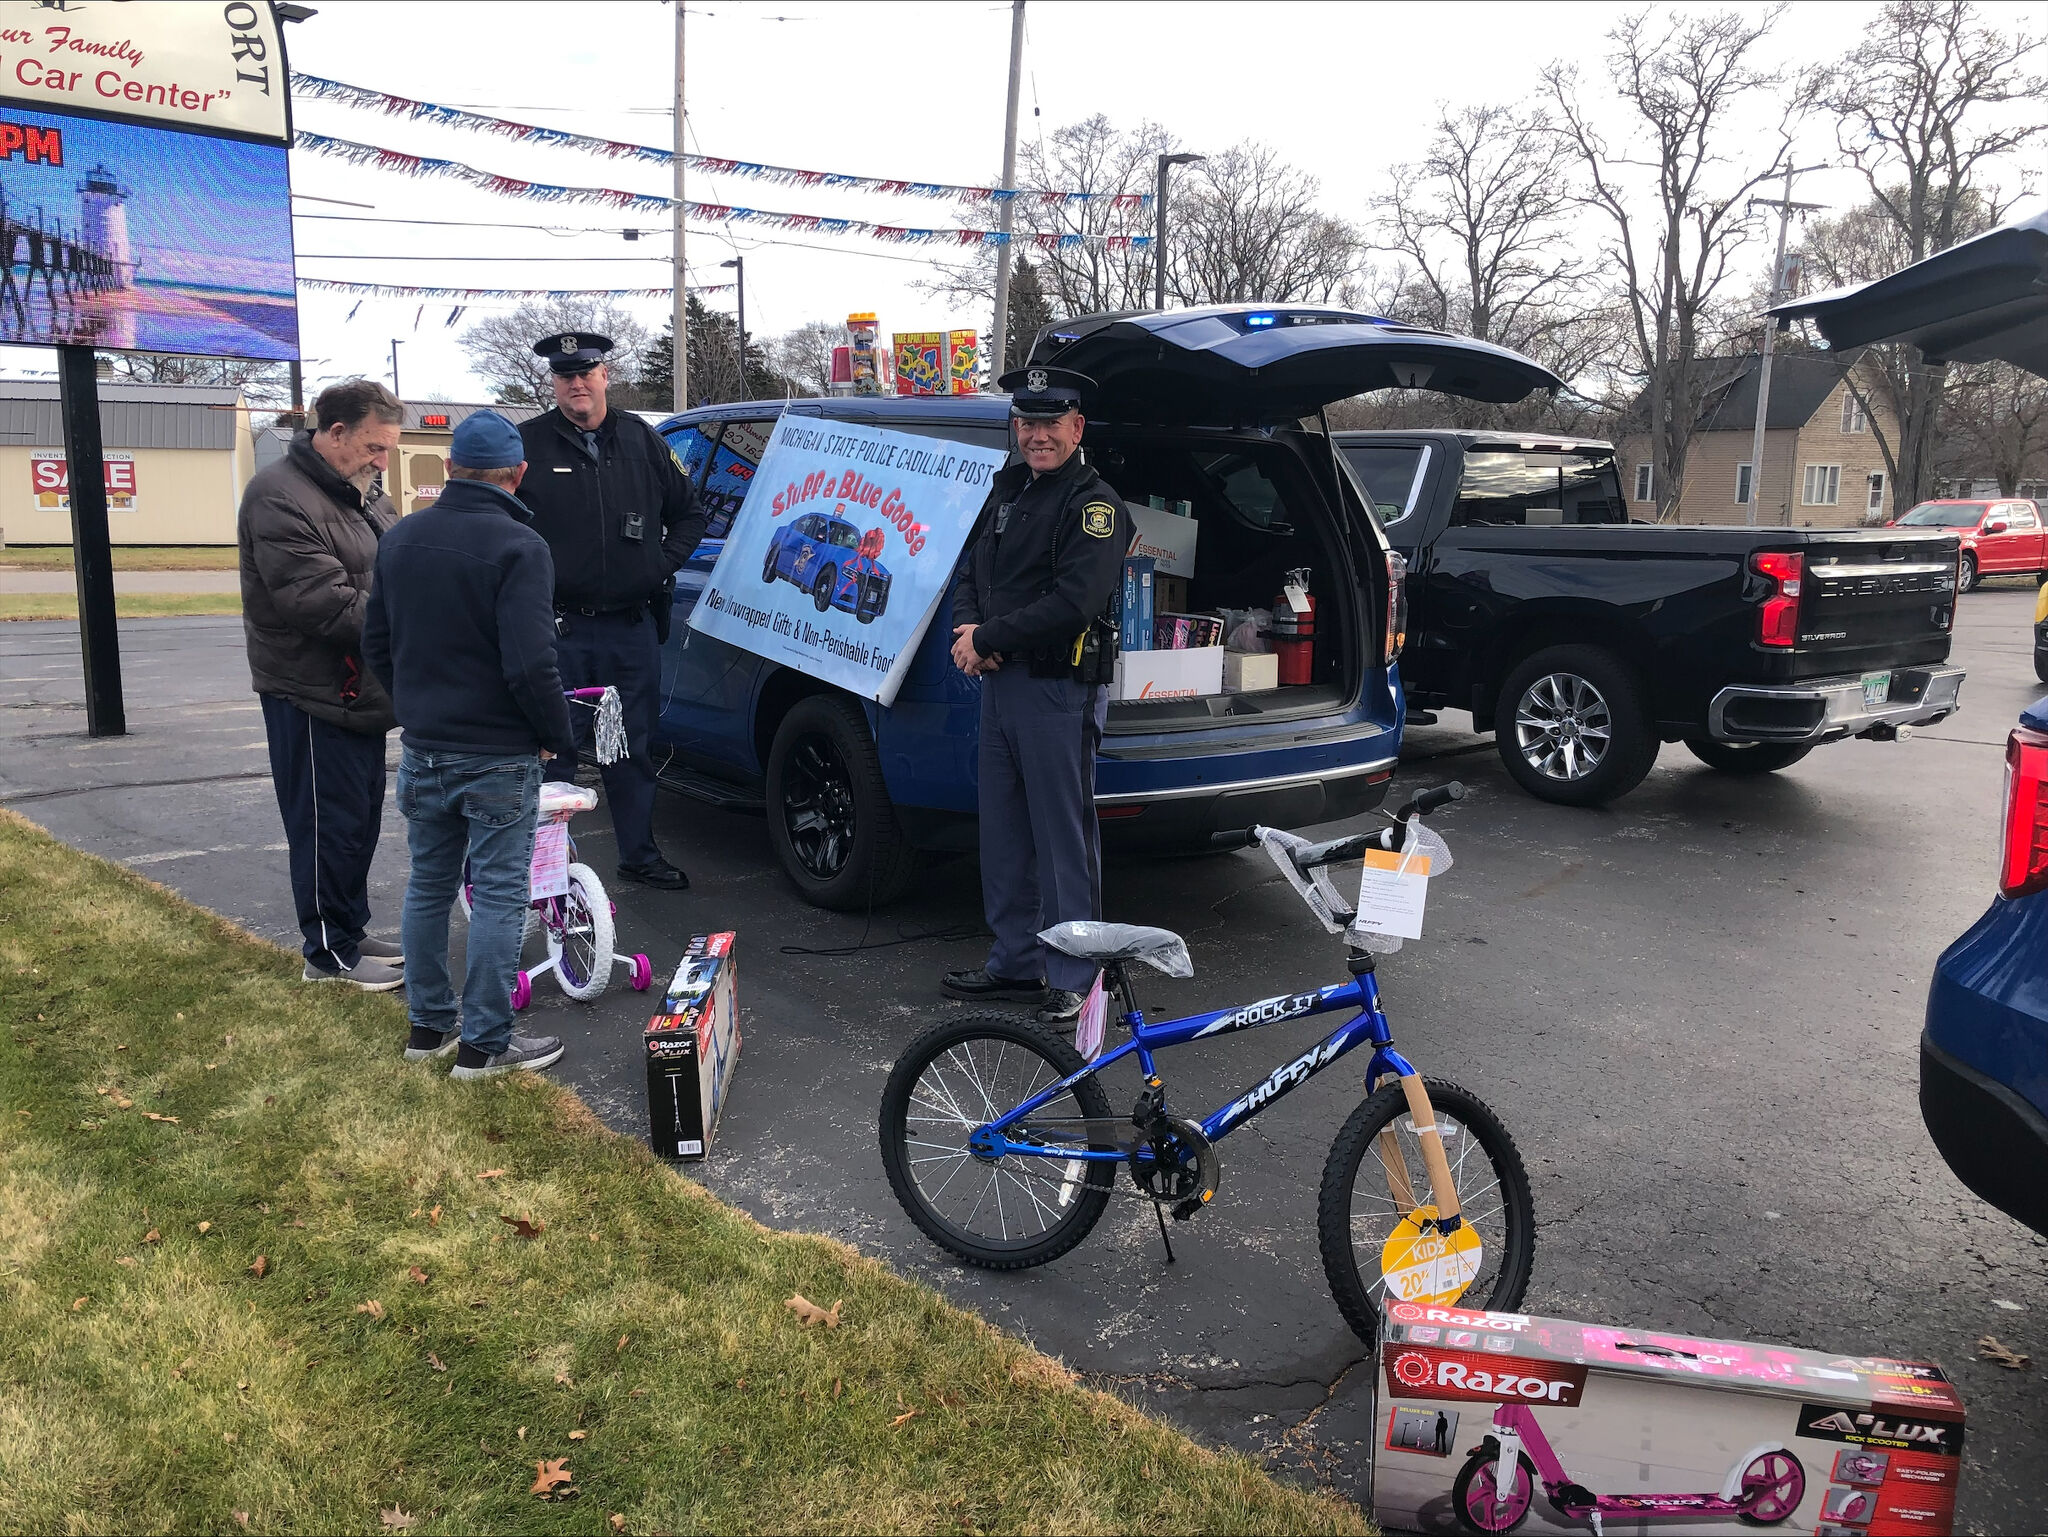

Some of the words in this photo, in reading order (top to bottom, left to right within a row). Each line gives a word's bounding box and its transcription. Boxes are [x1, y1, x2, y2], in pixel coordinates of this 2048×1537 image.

[45, 27, 145, 68] Family
[224, 2, 270, 97] ORT
[16, 58, 82, 91] Car
[0, 125, 61, 164] PM
[780, 427, 825, 451] MICHIGAN
[824, 434, 858, 458] STATE
[855, 440, 900, 467] POLICE
[896, 448, 955, 479] CADILLAC
[955, 459, 995, 487] POST
[420, 488, 440, 496] SALE
[1138, 544, 1177, 560] ESSENTIAL
[773, 611, 792, 637] Gifts
[794, 619, 802, 640] &
[1801, 632, 1846, 642] SILVERADO
[1235, 1000, 1287, 1028] ROCK
[1292, 994, 1318, 1011] IT
[659, 1041, 692, 1049] Razor
[1247, 1045, 1321, 1110] HUFFY
[1412, 1240, 1446, 1262] KIDS
[1427, 1309, 1532, 1332] Razor
[1437, 1361, 1575, 1401] Razor
[1846, 1435, 1865, 1443] KICK
[1866, 1437, 1910, 1448] SCOOTER
[1871, 1421, 1946, 1444] LUX
